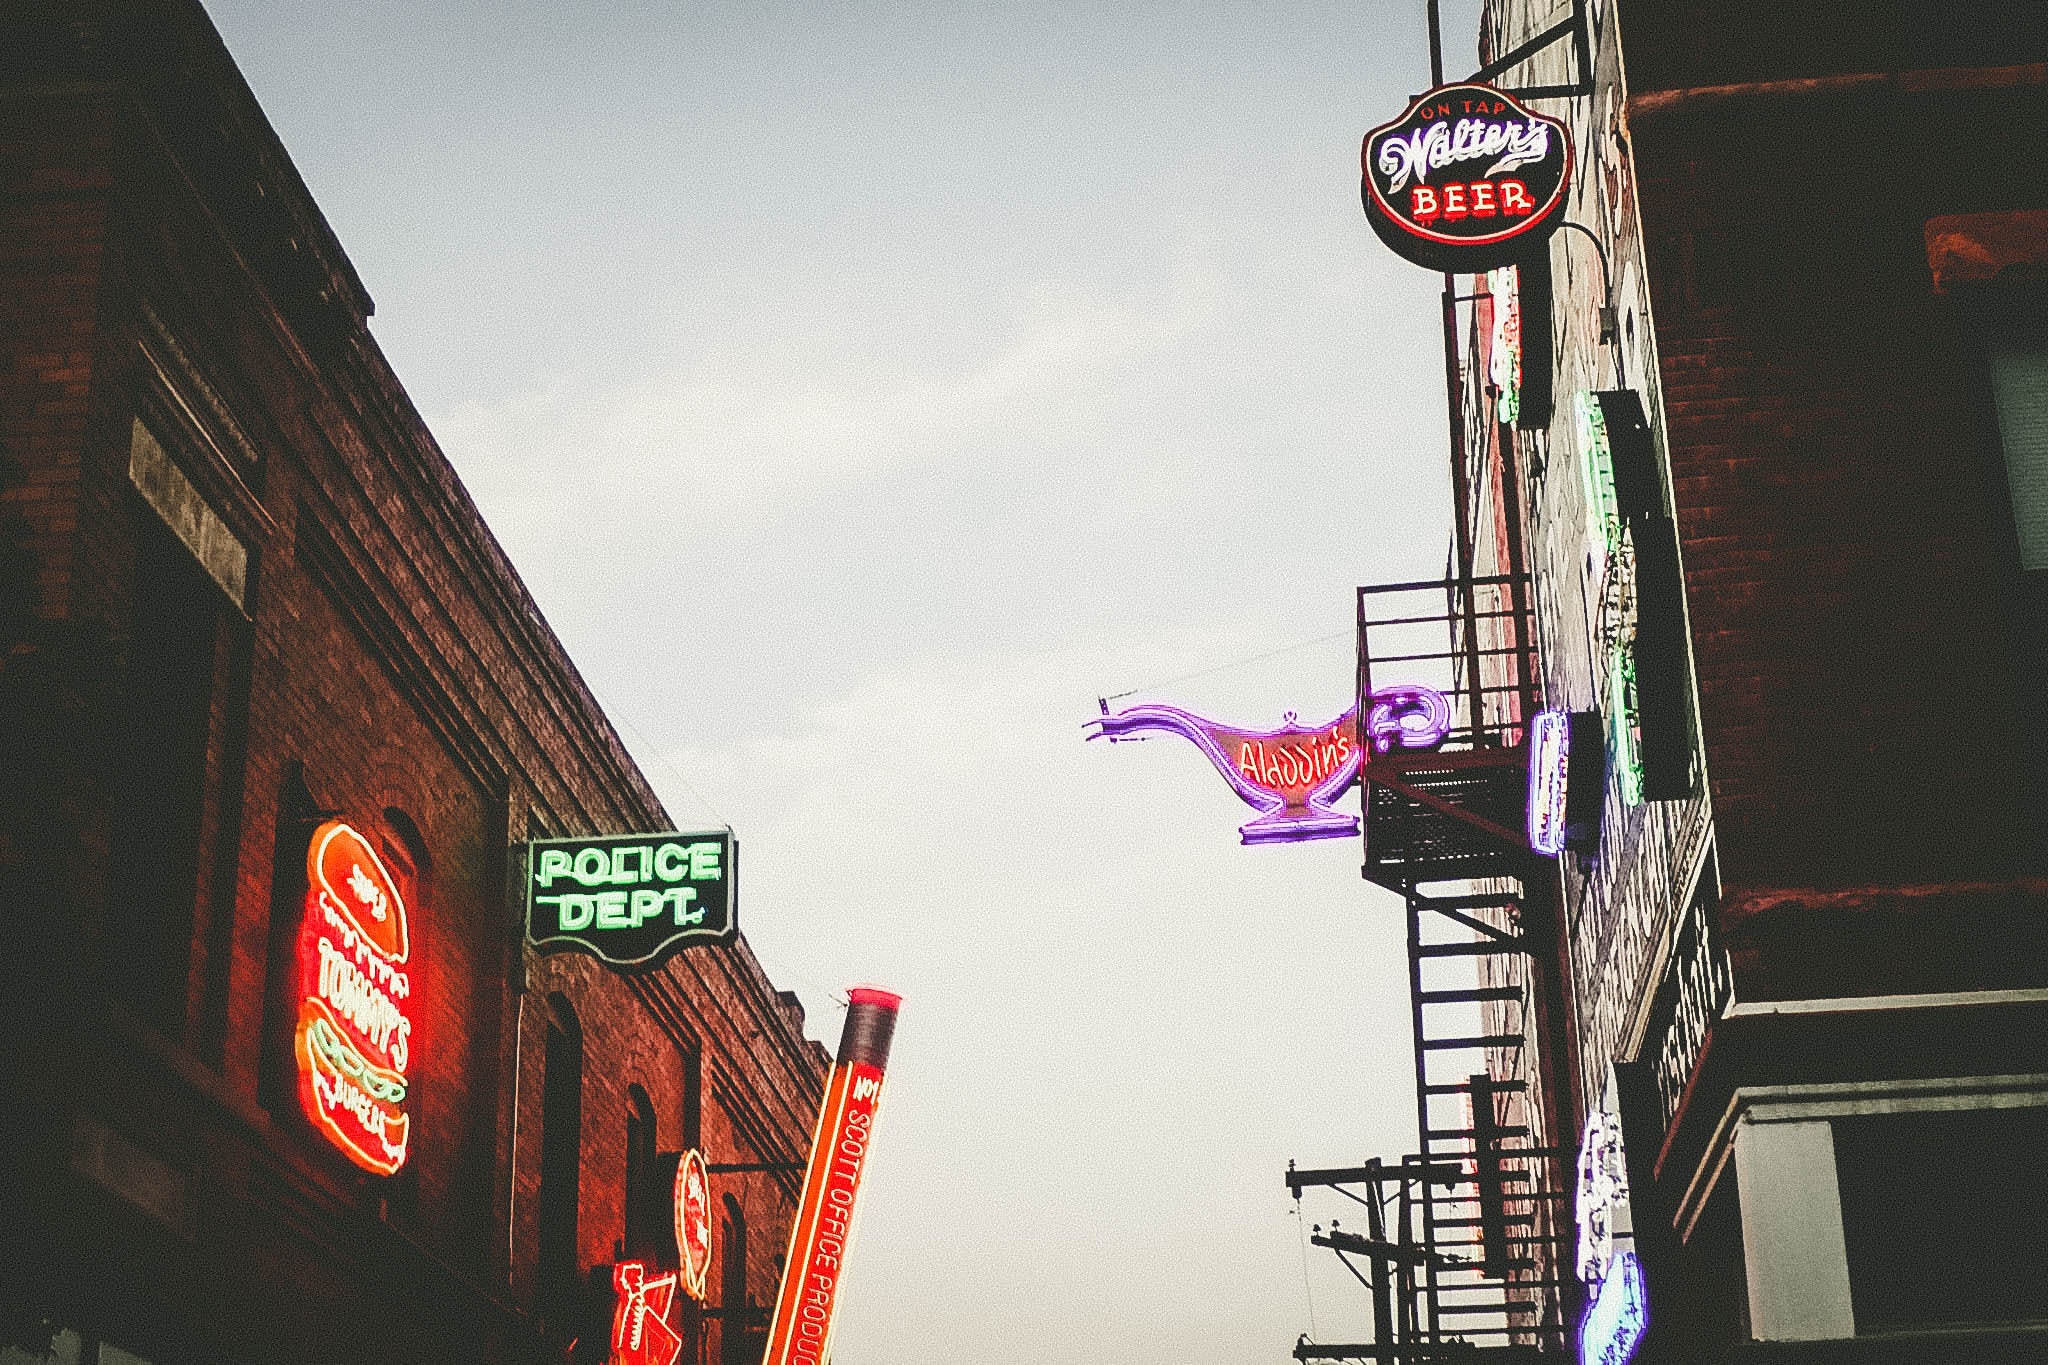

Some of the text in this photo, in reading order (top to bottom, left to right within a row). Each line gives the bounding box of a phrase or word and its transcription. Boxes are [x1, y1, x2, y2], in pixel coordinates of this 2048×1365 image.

[1420, 100, 1506, 120] ON TAP
[1379, 117, 1549, 195] Walter's
[1412, 180, 1534, 218] BEER
[534, 841, 722, 888] POLICE
[833, 1108, 871, 1187] SCOTT
[815, 1187, 854, 1272] OFFICE
